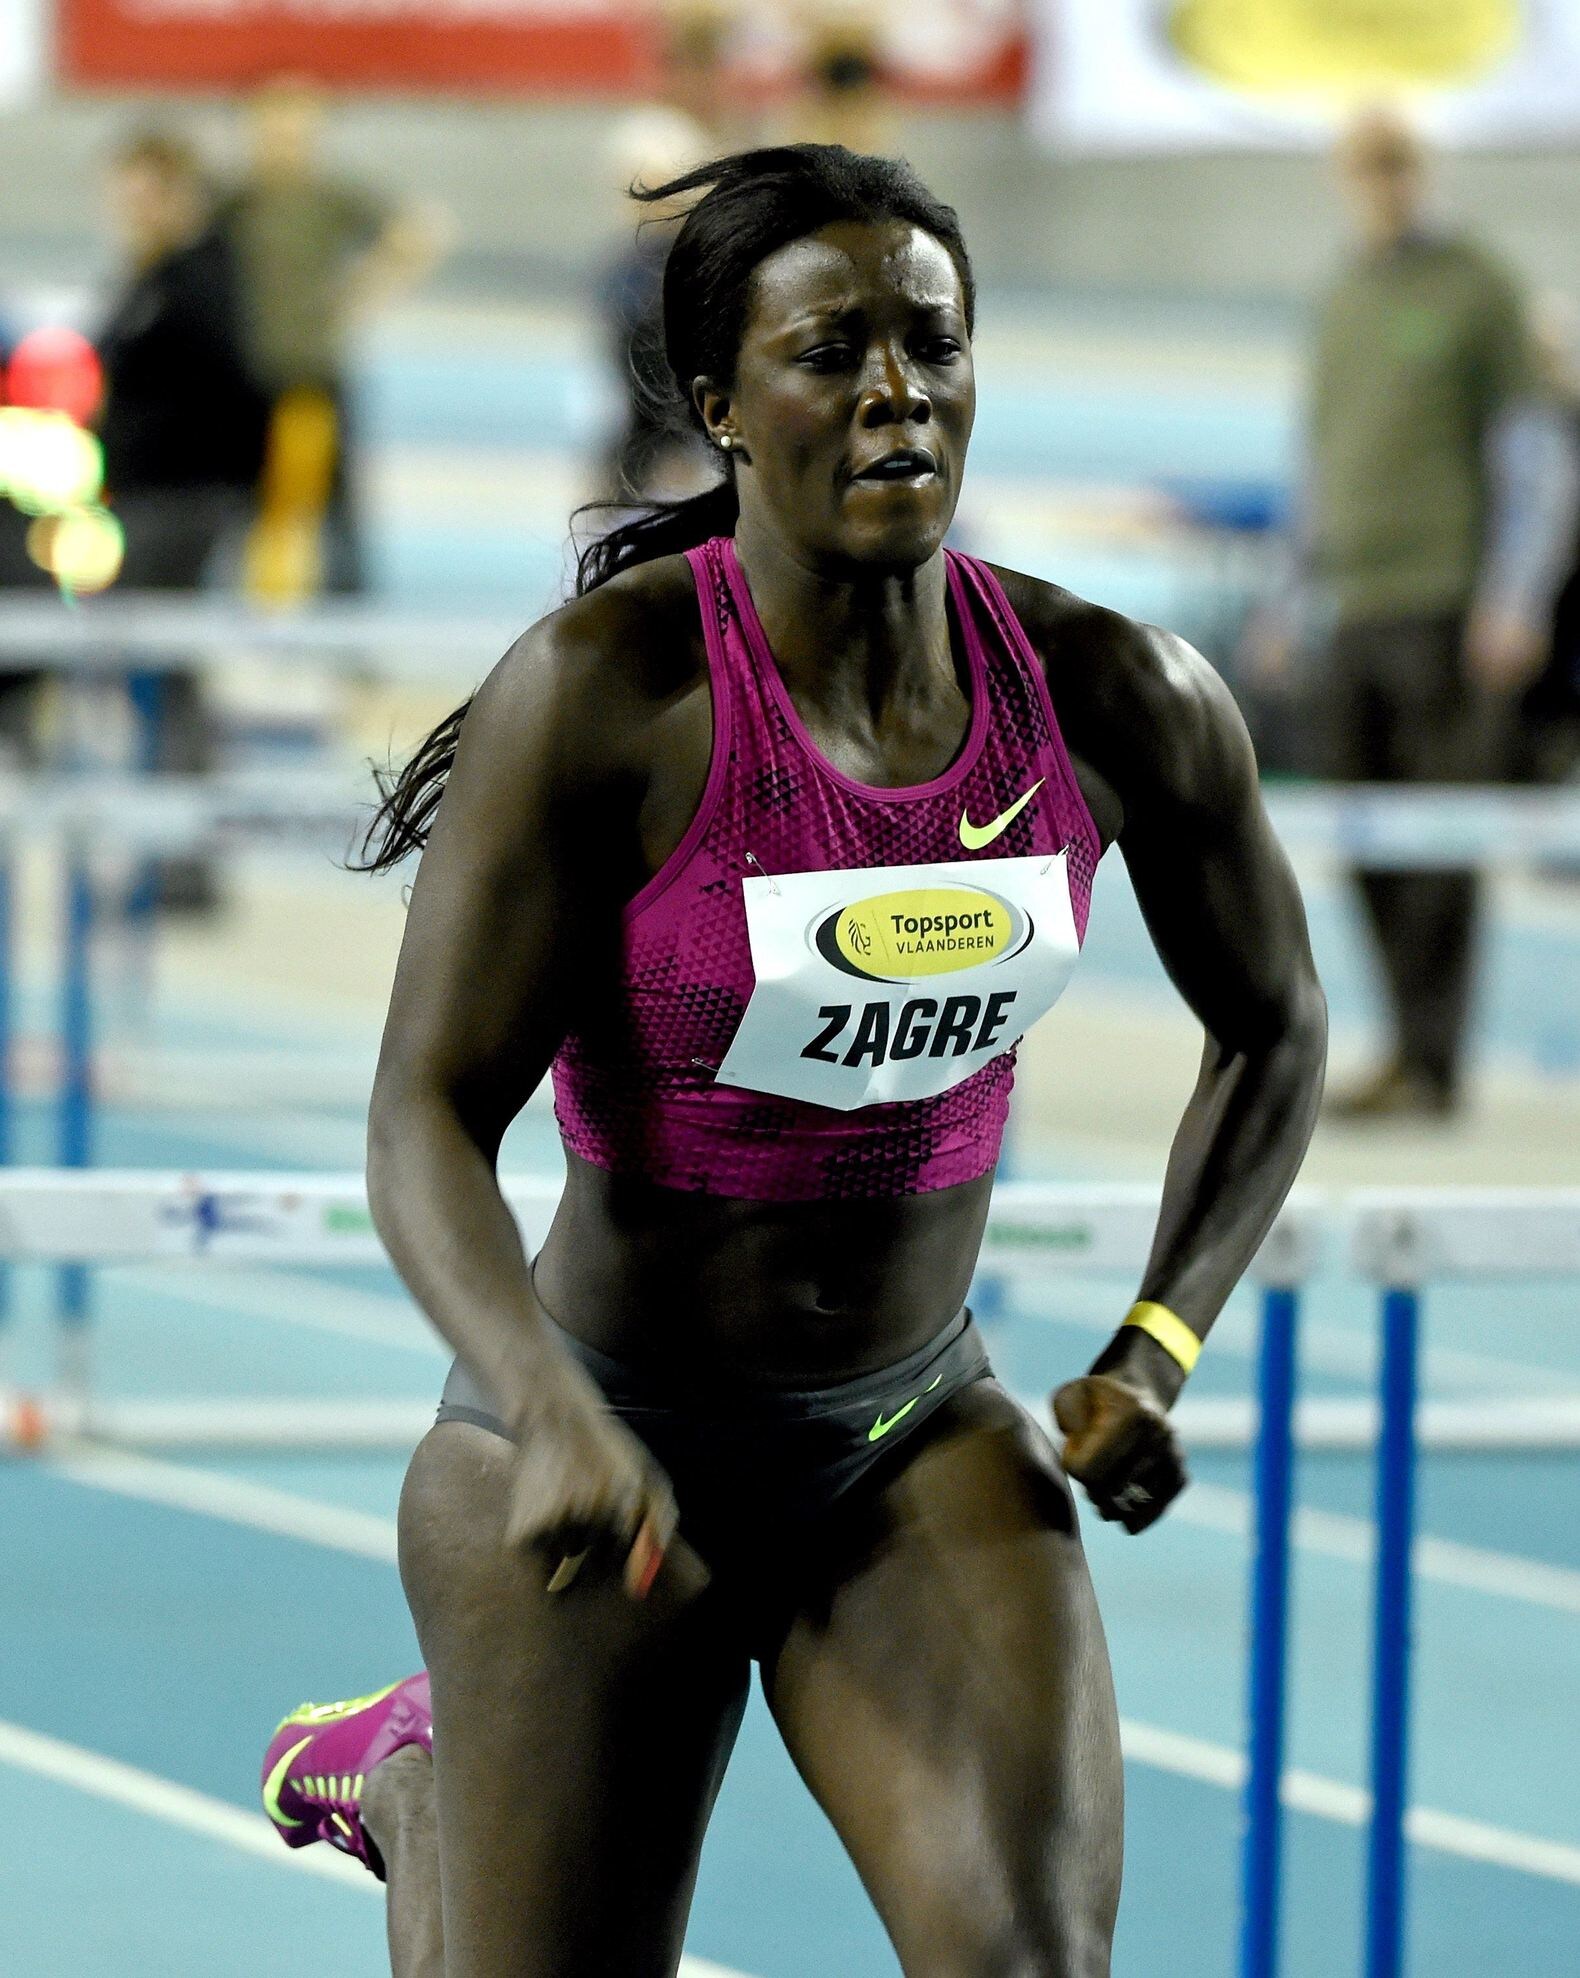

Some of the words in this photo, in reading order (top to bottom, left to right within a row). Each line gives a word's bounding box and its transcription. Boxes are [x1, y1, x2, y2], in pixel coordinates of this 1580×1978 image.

[890, 909, 994, 938] Topsport
[896, 935, 995, 954] VLAANDEREN
[800, 990, 1018, 1068] ZAGRE
